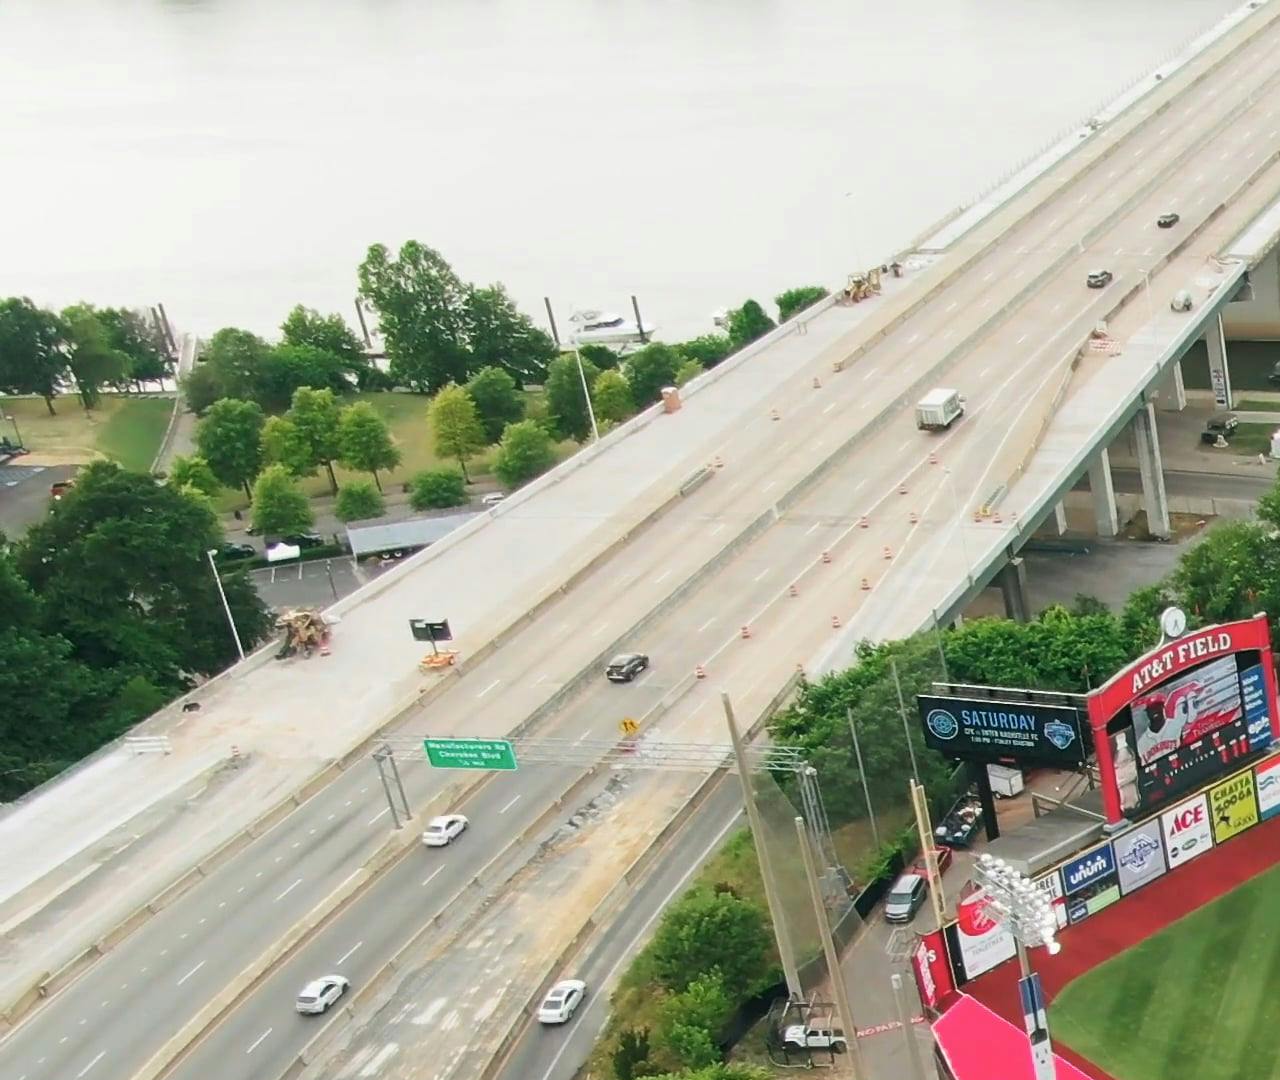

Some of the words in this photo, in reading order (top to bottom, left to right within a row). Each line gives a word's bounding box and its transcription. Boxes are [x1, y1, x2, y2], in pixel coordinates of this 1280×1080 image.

[1132, 652, 1174, 694] AT&T
[1177, 633, 1232, 664] FIELD
[961, 710, 1036, 731] SATURDAY
[1213, 775, 1250, 802] CHATTA
[1170, 803, 1204, 837] ACE
[1069, 856, 1107, 885] unum
